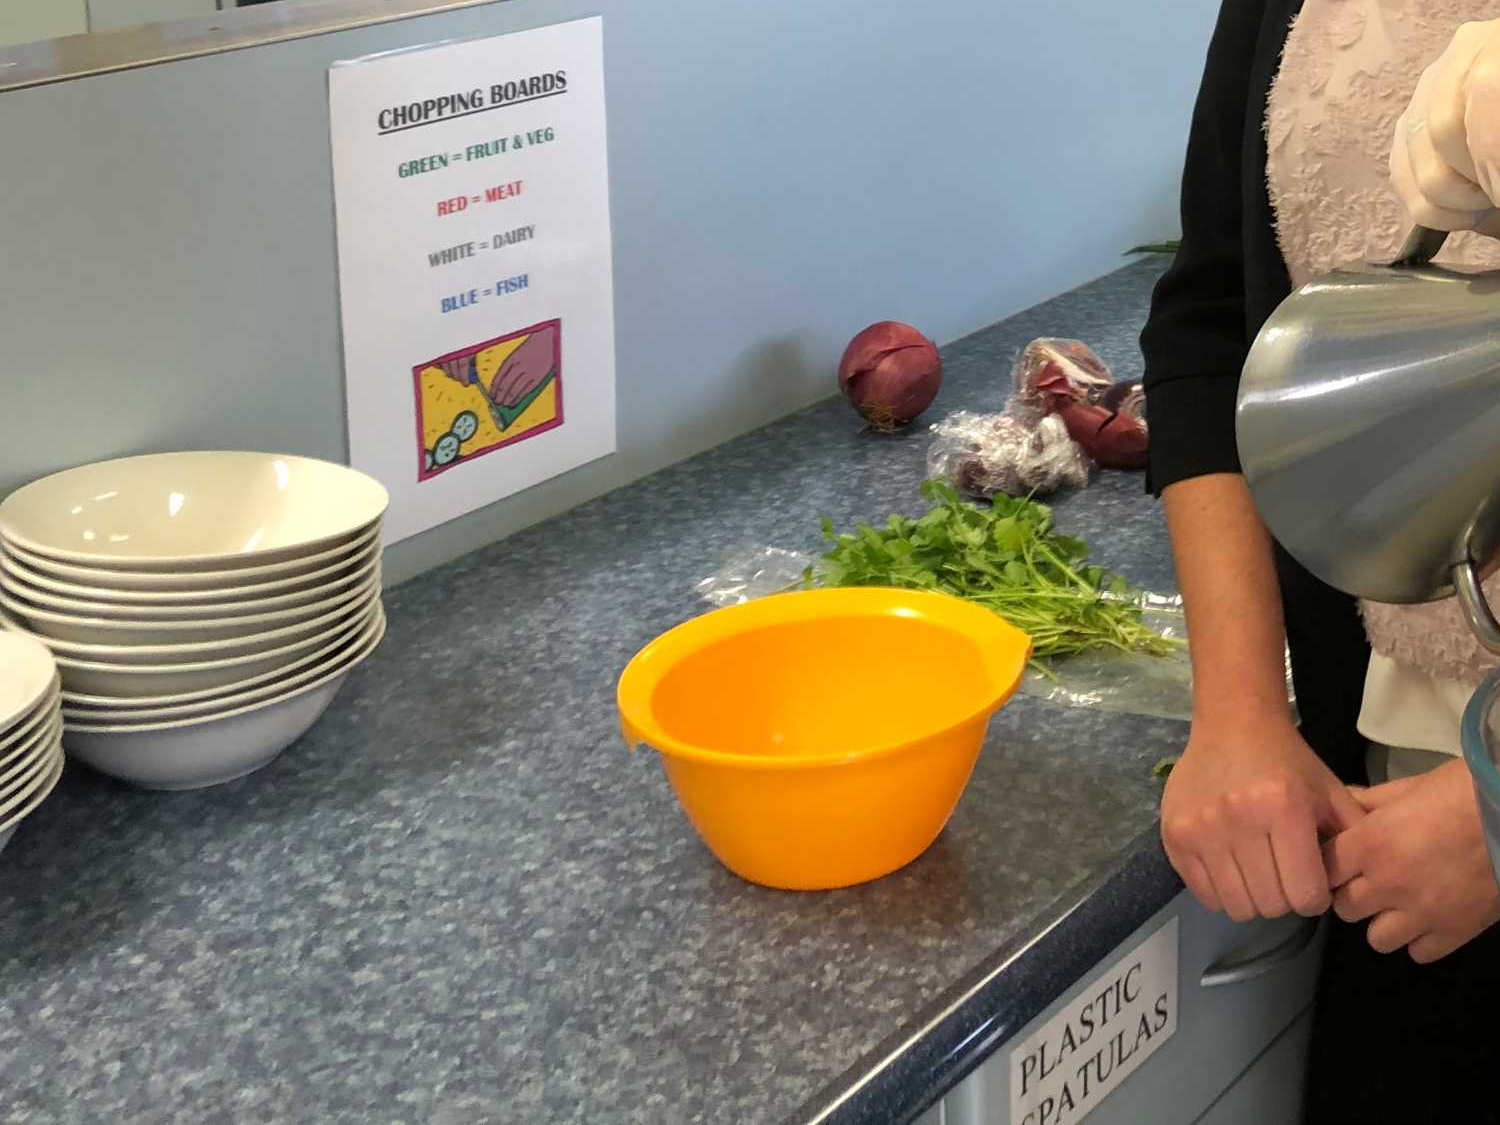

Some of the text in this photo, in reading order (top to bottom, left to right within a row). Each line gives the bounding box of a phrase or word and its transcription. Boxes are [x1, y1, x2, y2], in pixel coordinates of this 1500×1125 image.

[378, 70, 567, 131] CHOPPING BOARDS
[398, 153, 449, 178] GREEN
[466, 137, 508, 162] FRUIT
[512, 135, 523, 150] &
[527, 127, 554, 146] VEG
[437, 196, 468, 217] RED
[485, 180, 523, 203] MEAT
[428, 241, 475, 268] WHITE
[493, 225, 536, 250] DAIRY
[441, 289, 478, 314] BLUE
[496, 273, 529, 297] FISH
[1020, 962, 1142, 1098] PLASTIC
